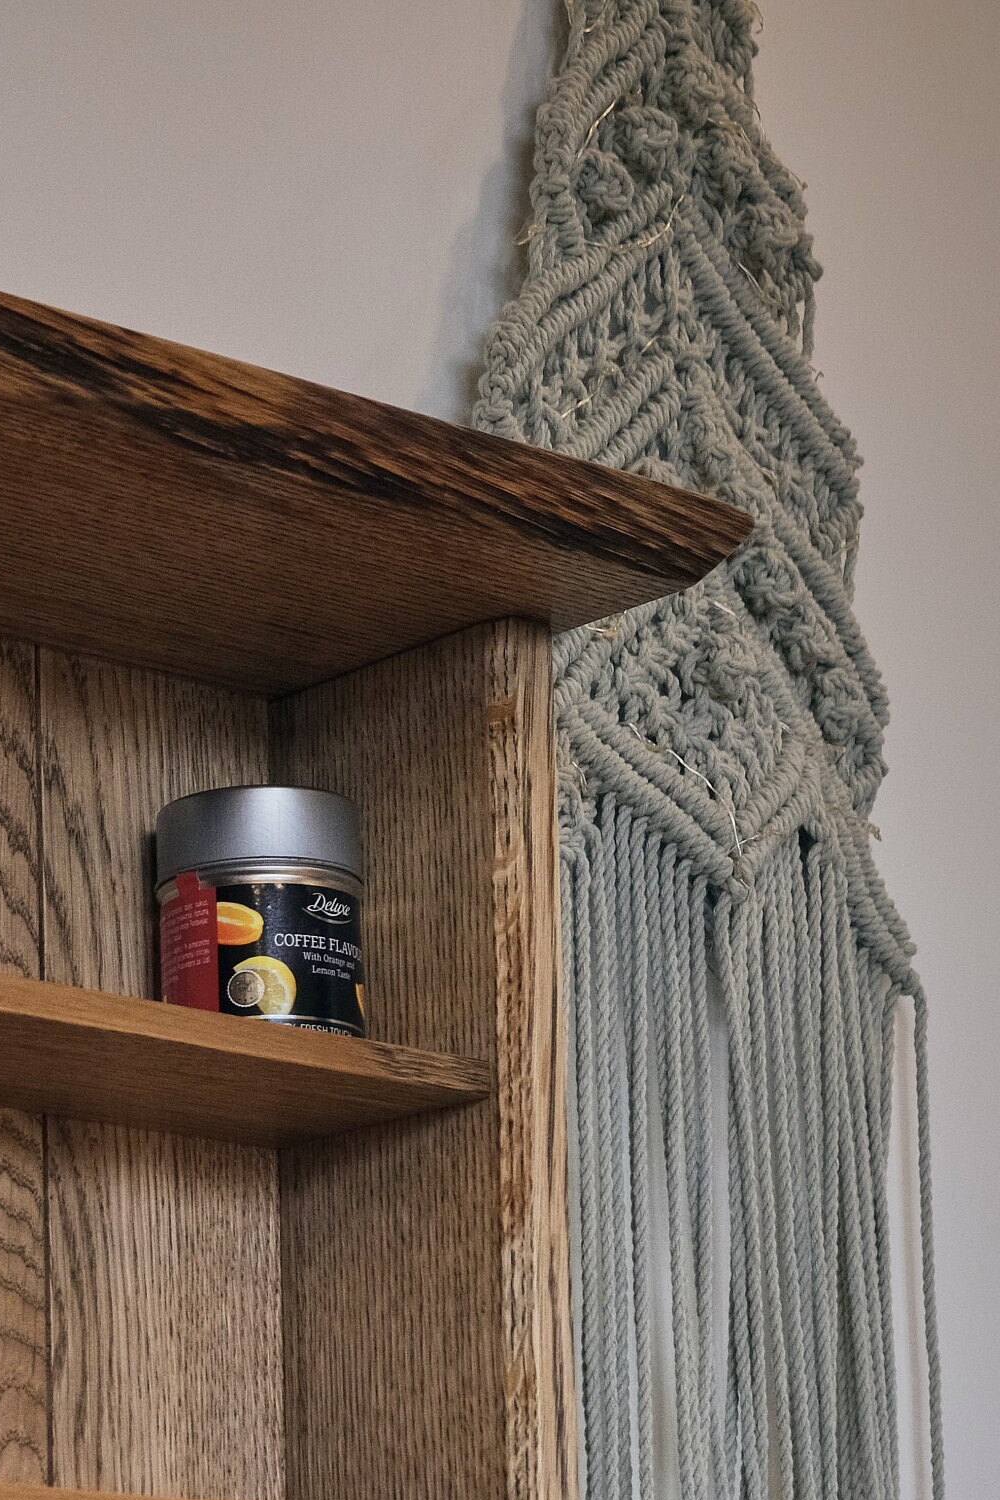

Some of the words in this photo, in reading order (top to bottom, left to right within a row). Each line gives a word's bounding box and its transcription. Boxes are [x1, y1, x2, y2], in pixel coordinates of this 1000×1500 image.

[306, 892, 351, 917] Deluxe
[273, 933, 327, 950] COFFEE
[302, 951, 322, 962] With
[323, 954, 346, 967] Orange
[311, 965, 336, 977] Lemon
